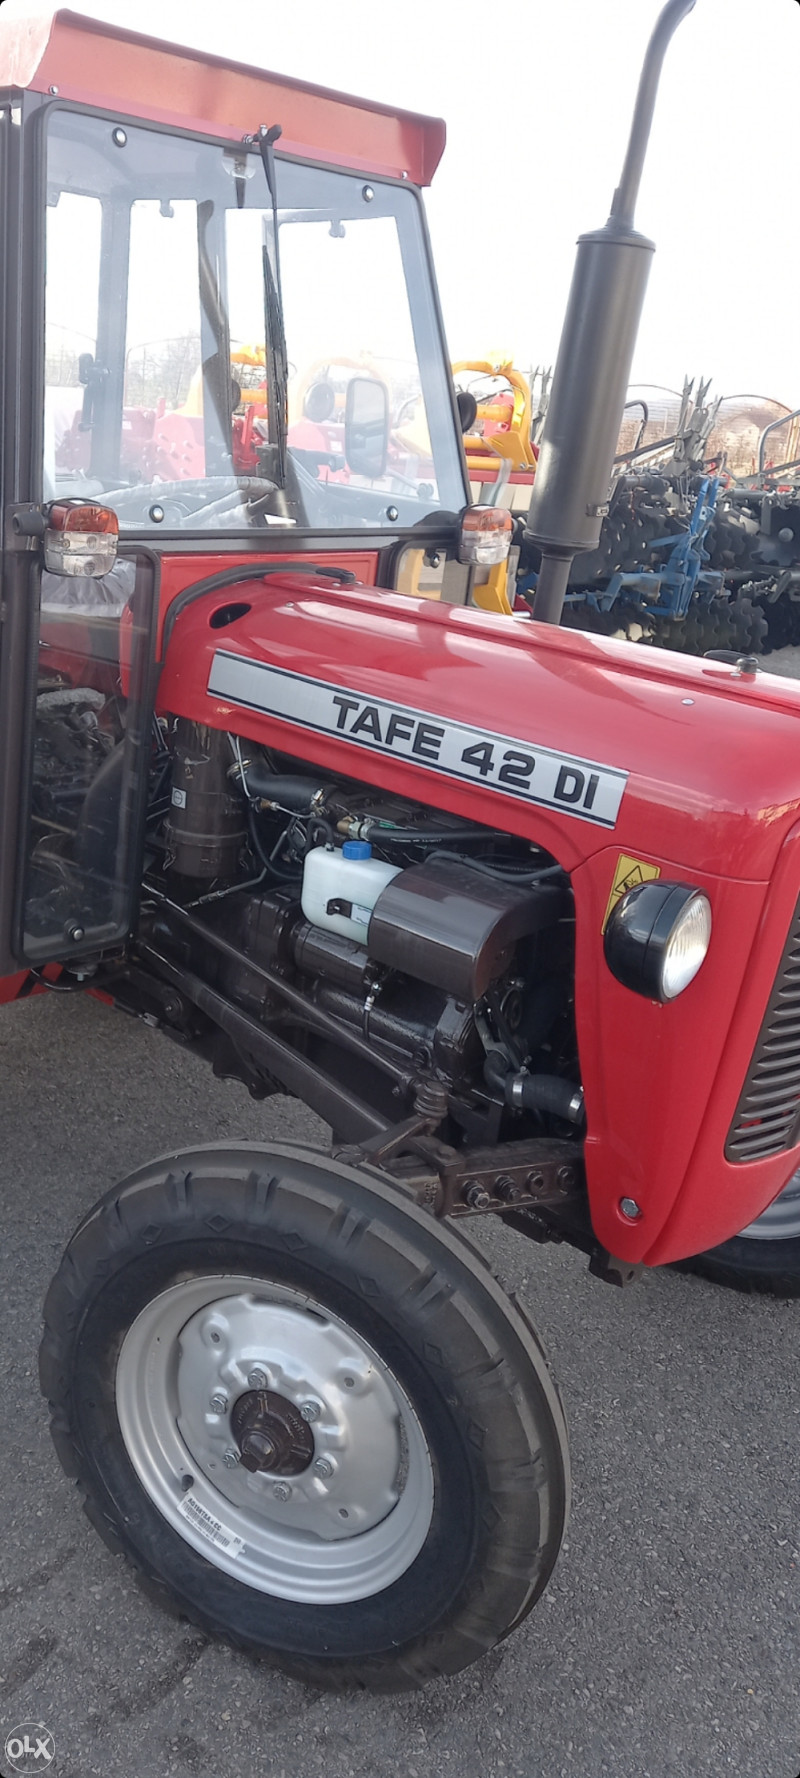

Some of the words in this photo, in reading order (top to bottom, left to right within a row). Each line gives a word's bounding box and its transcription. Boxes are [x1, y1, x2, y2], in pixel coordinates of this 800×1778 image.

[333, 696, 445, 760] TAFE
[461, 741, 536, 789] 42
[553, 765, 600, 810] DI
